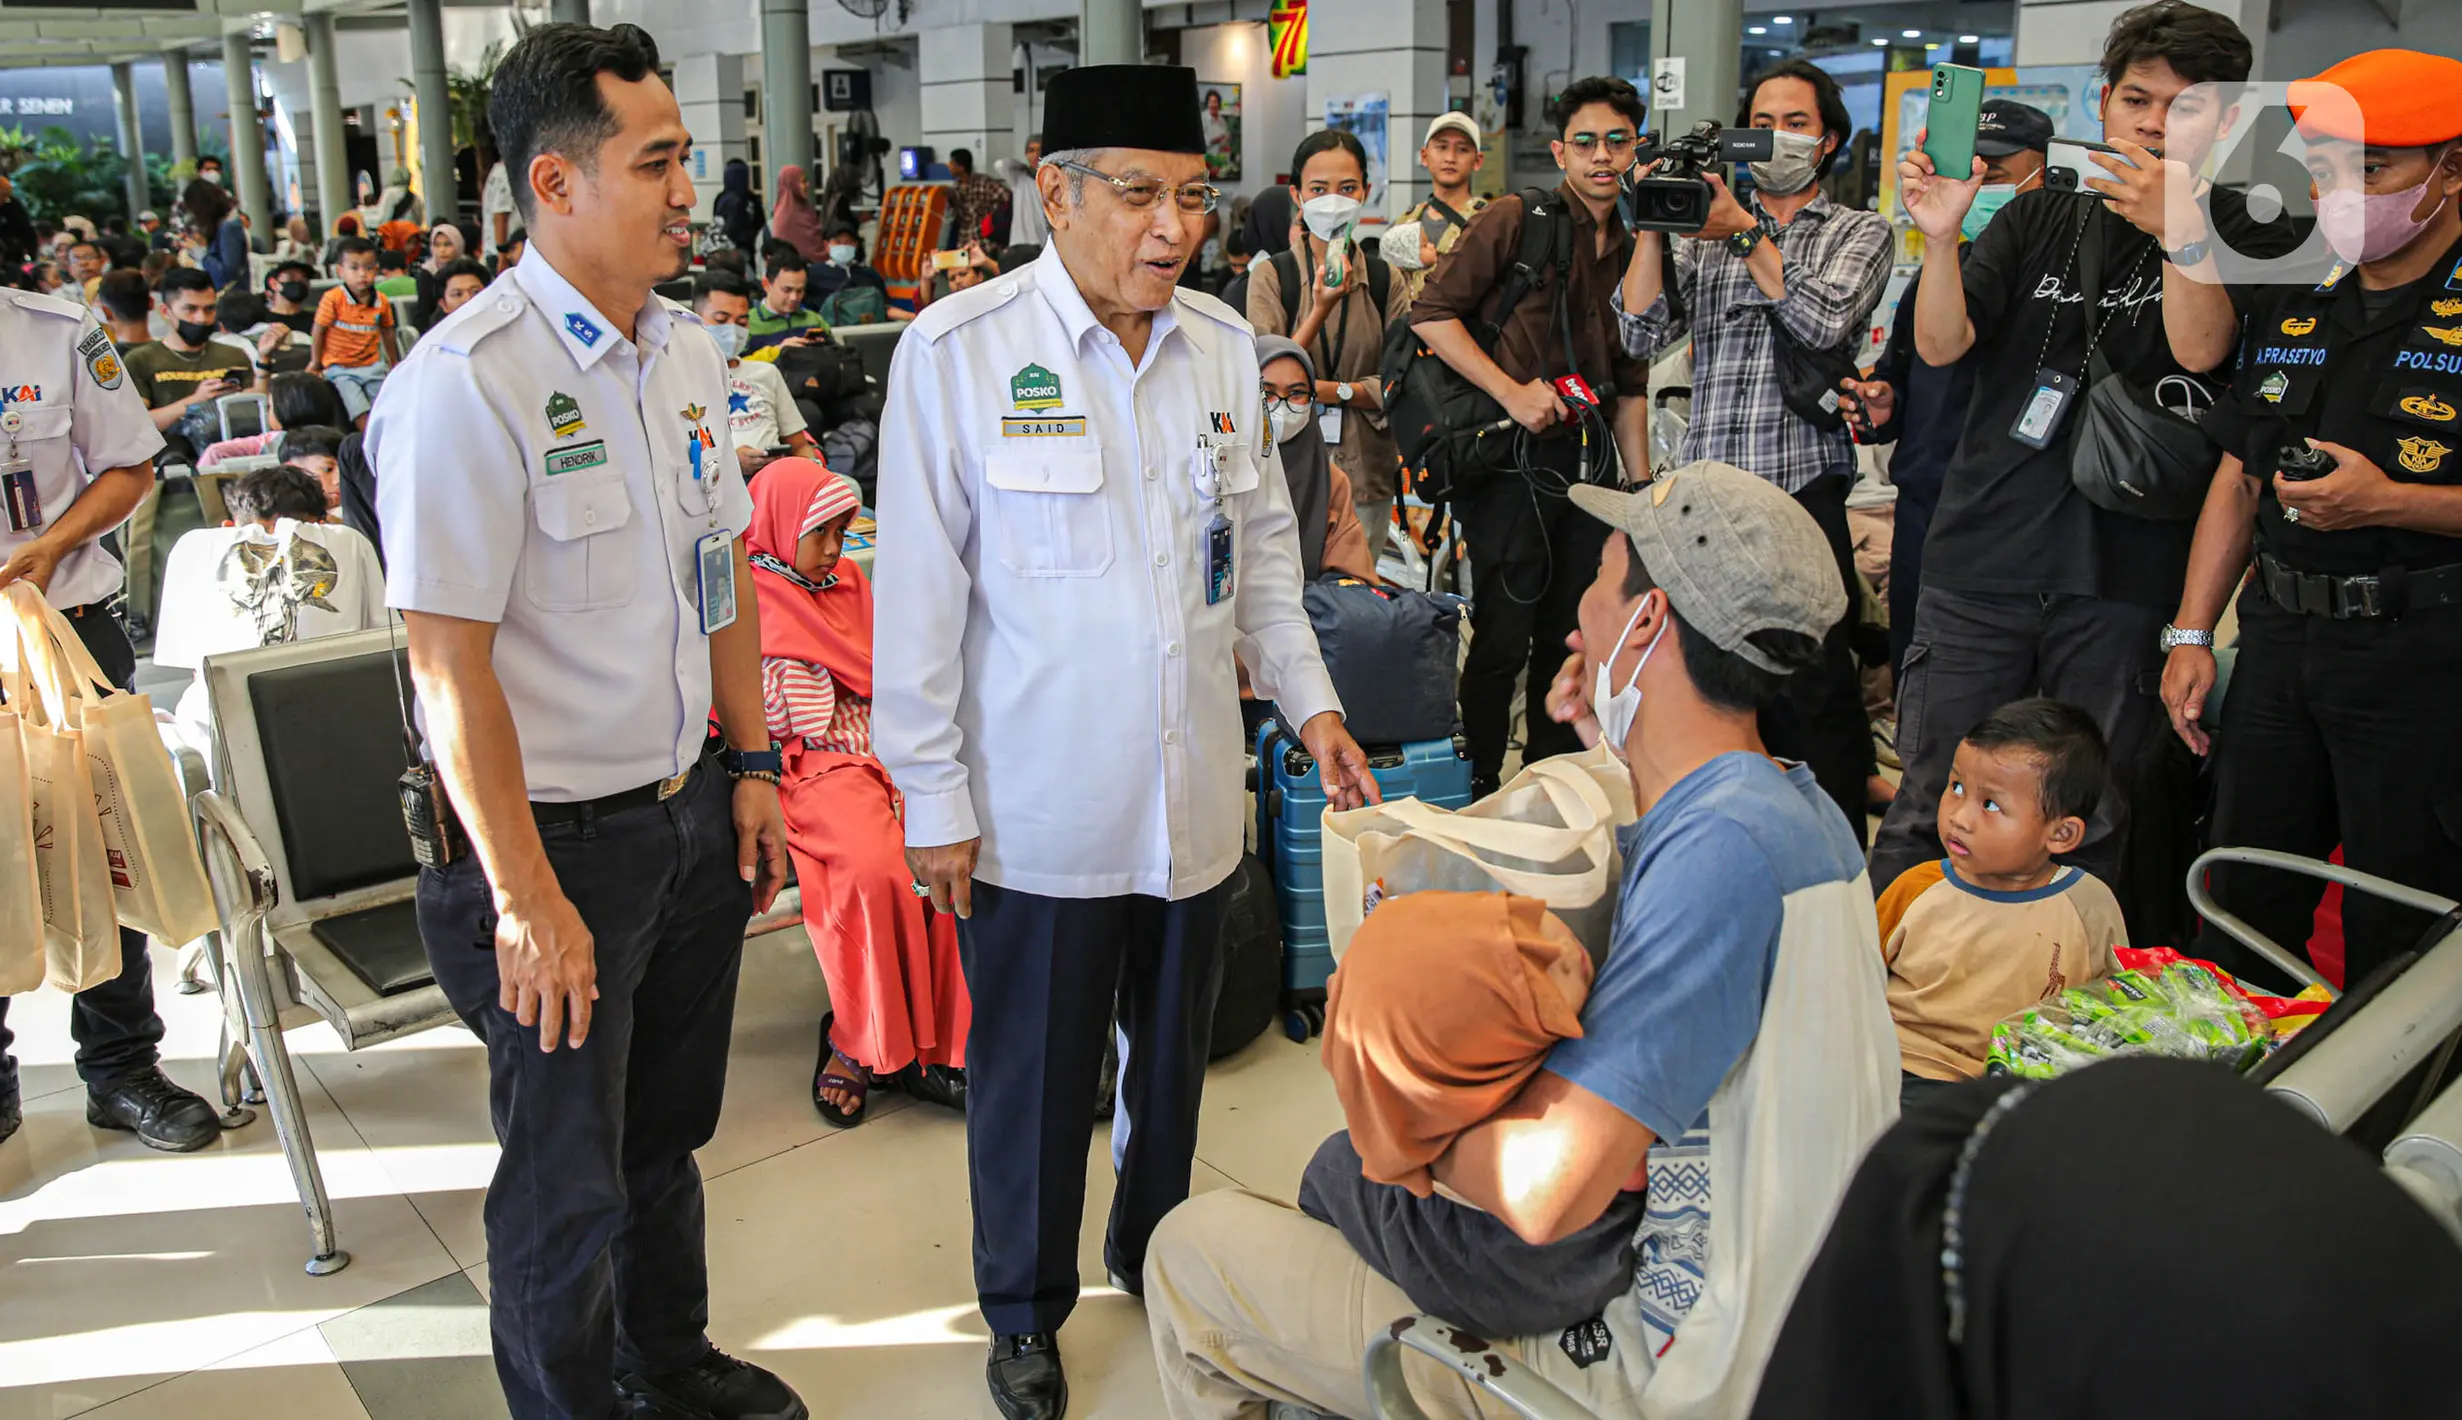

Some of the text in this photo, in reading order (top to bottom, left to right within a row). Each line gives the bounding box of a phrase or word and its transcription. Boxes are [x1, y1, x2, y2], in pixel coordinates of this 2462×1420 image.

[17, 97, 73, 115] SENEN
[2254, 347, 2327, 366] A.PRASETYO
[2393, 350, 2462, 374] POLSU
[2, 384, 42, 404] KAI
[1016, 386, 1057, 398] POSKO
[2260, 386, 2282, 395] POSKO
[551, 408, 580, 427] POSKO
[1210, 411, 1236, 434] KAI
[1022, 423, 1065, 434] SAID
[560, 450, 598, 468] HENDRIK
[1566, 1330, 1576, 1353] 1968
[1591, 1321, 1609, 1348] CSR
